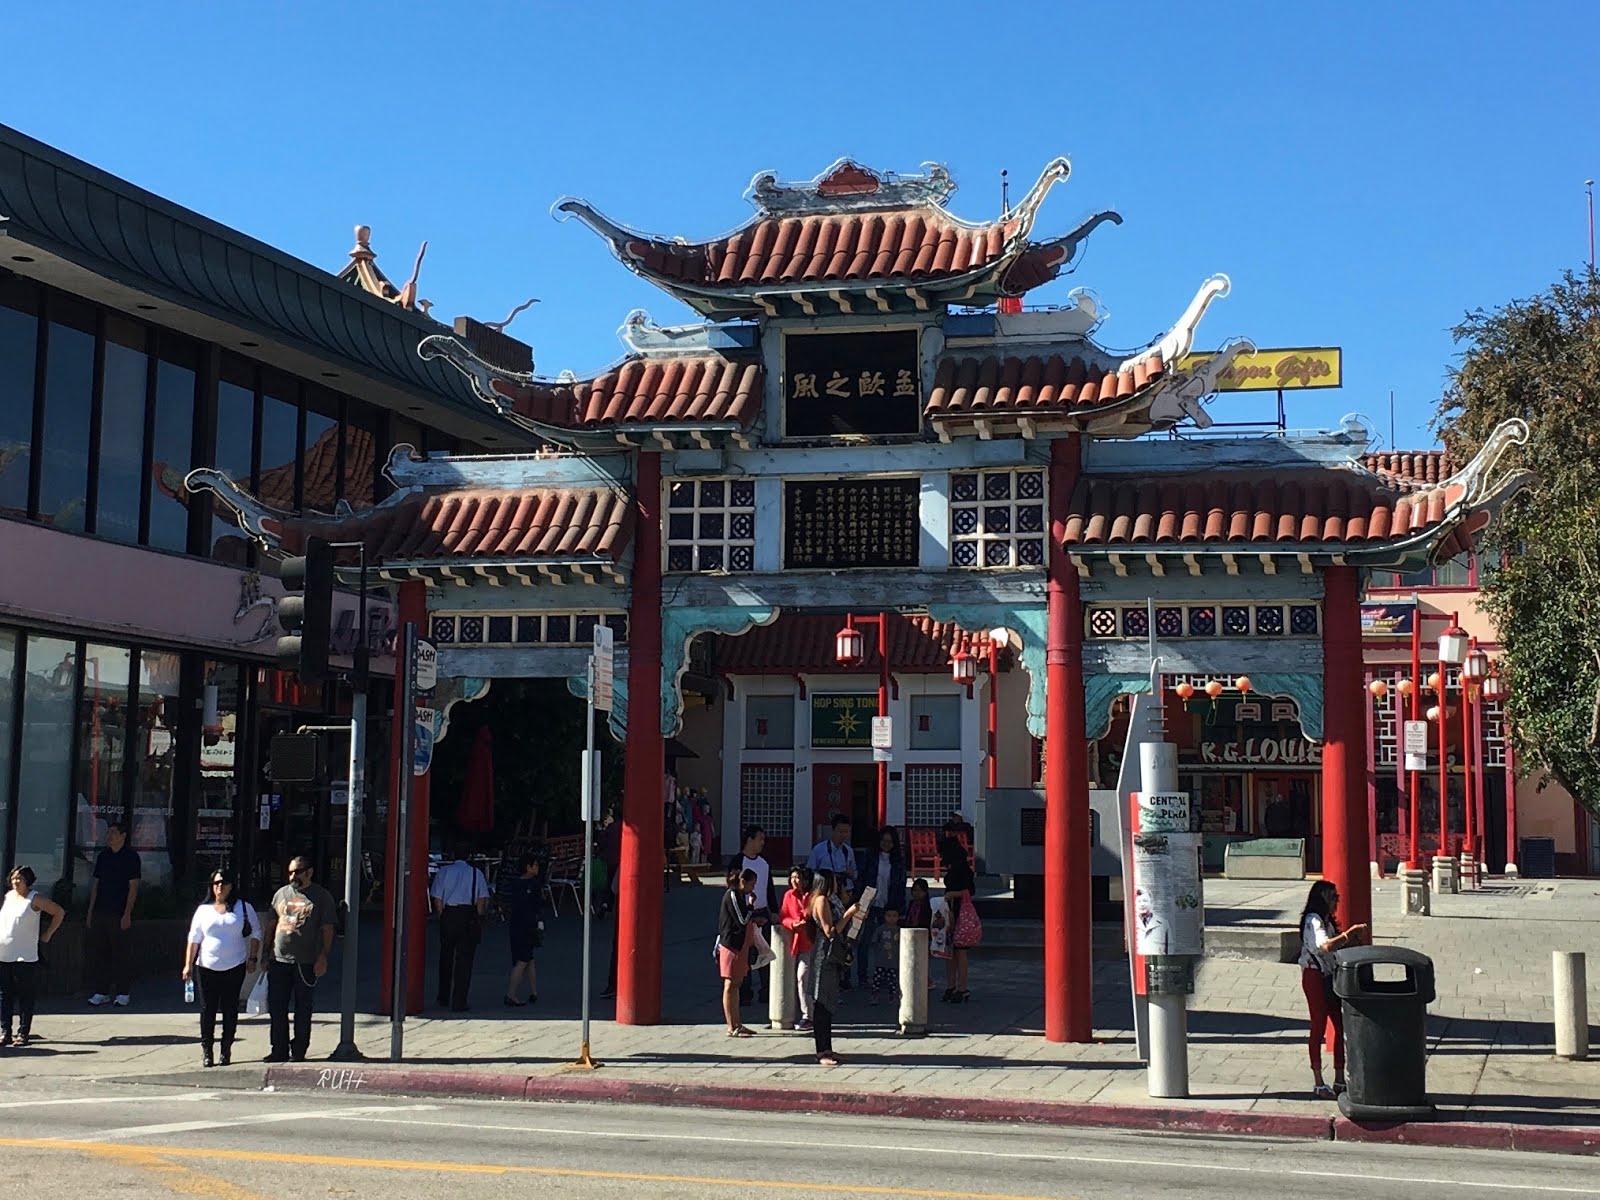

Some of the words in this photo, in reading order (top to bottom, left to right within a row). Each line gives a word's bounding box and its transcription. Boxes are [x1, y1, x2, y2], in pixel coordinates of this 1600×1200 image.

[813, 697, 832, 708] HOP
[833, 697, 854, 708] SING
[1150, 796, 1187, 806] CENTAL
